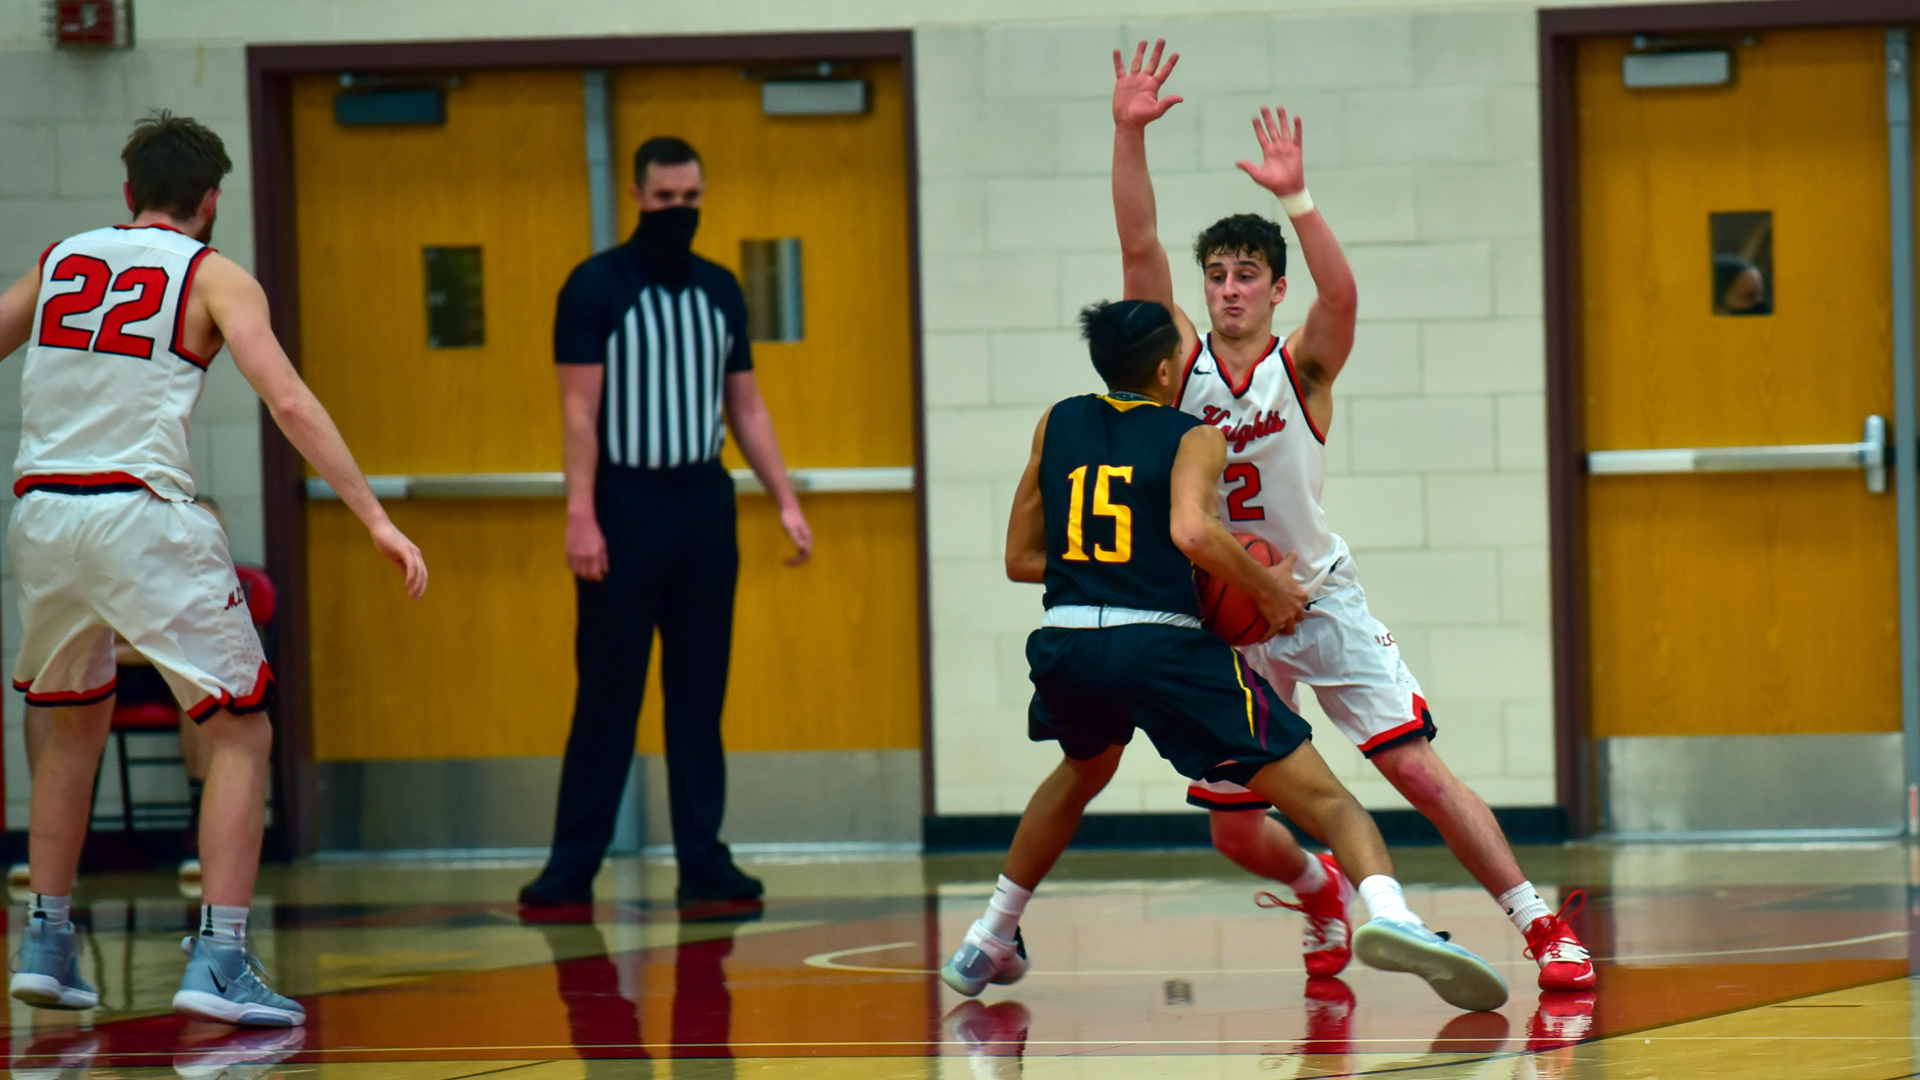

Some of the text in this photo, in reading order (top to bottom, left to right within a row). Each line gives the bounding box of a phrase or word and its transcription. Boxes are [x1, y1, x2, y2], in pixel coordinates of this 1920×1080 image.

[38, 253, 170, 360] 22
[1061, 464, 1134, 563] 15
[1223, 462, 1265, 522] 2
